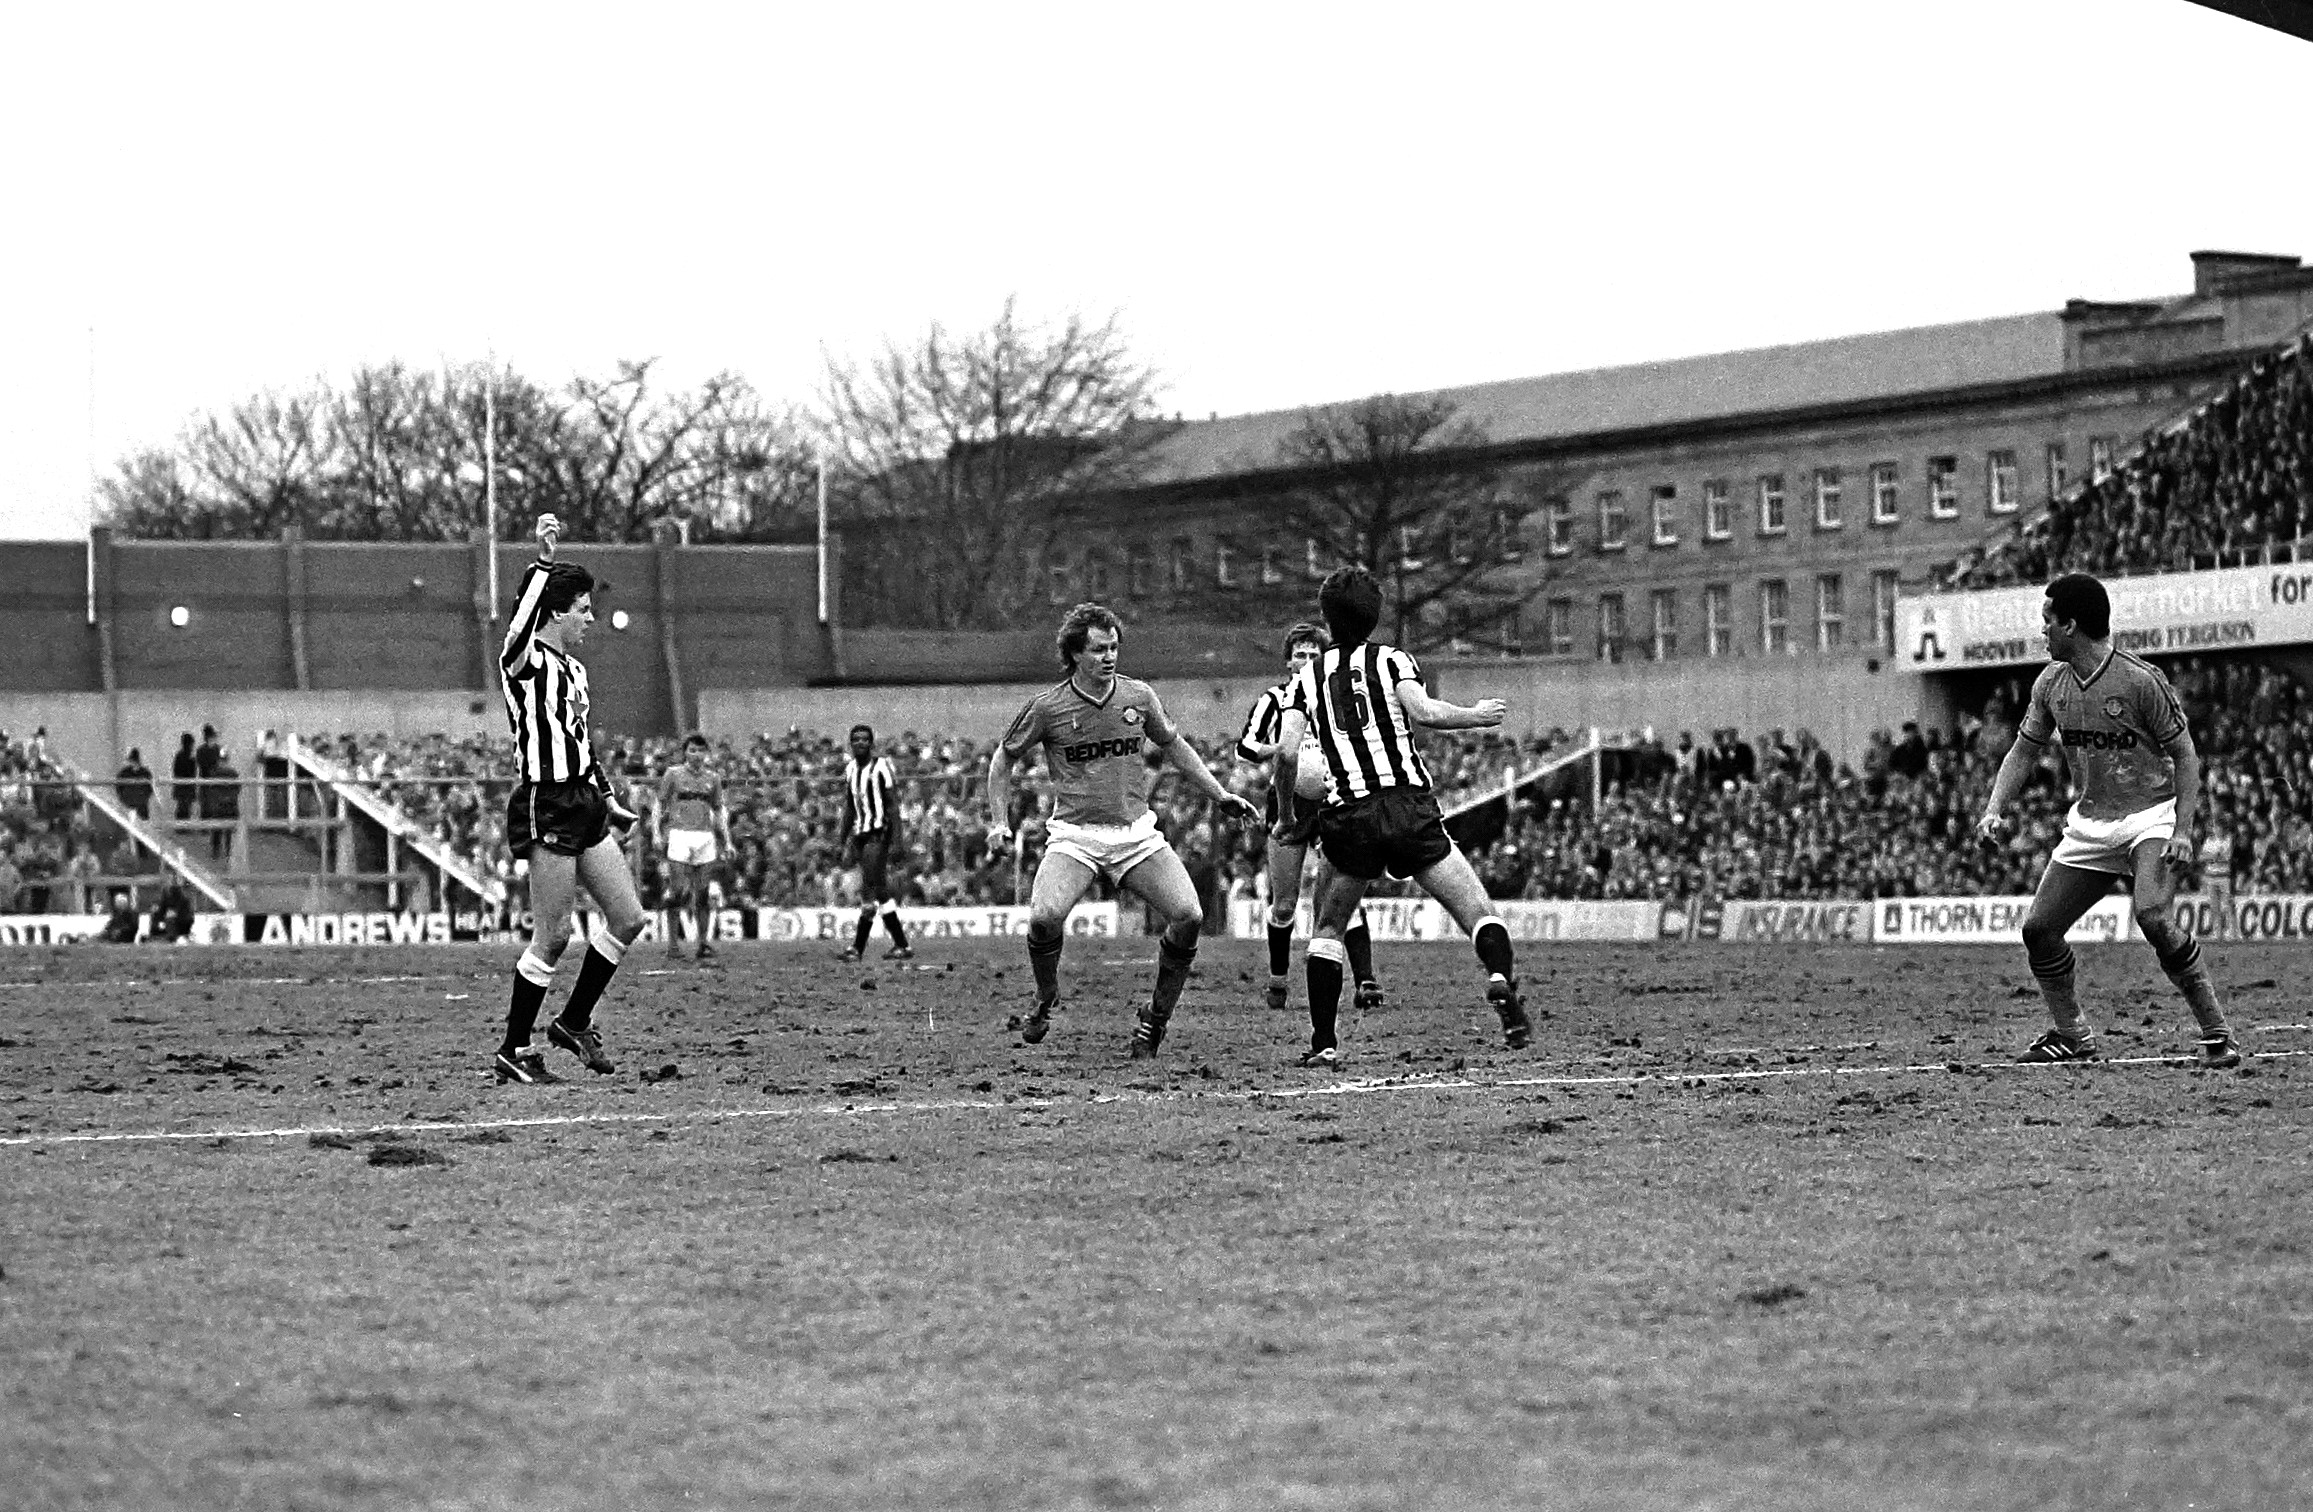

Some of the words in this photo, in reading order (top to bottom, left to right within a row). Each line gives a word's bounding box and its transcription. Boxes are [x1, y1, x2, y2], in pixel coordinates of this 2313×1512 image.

[2271, 573, 2312, 605] for
[1323, 667, 1373, 734] 6
[2062, 729, 2138, 749] EFORD
[260, 911, 451, 944] ANDREWS
[986, 911, 1108, 937] Hoes
[1908, 902, 1985, 933] THORN
[1989, 902, 2026, 933] EM
